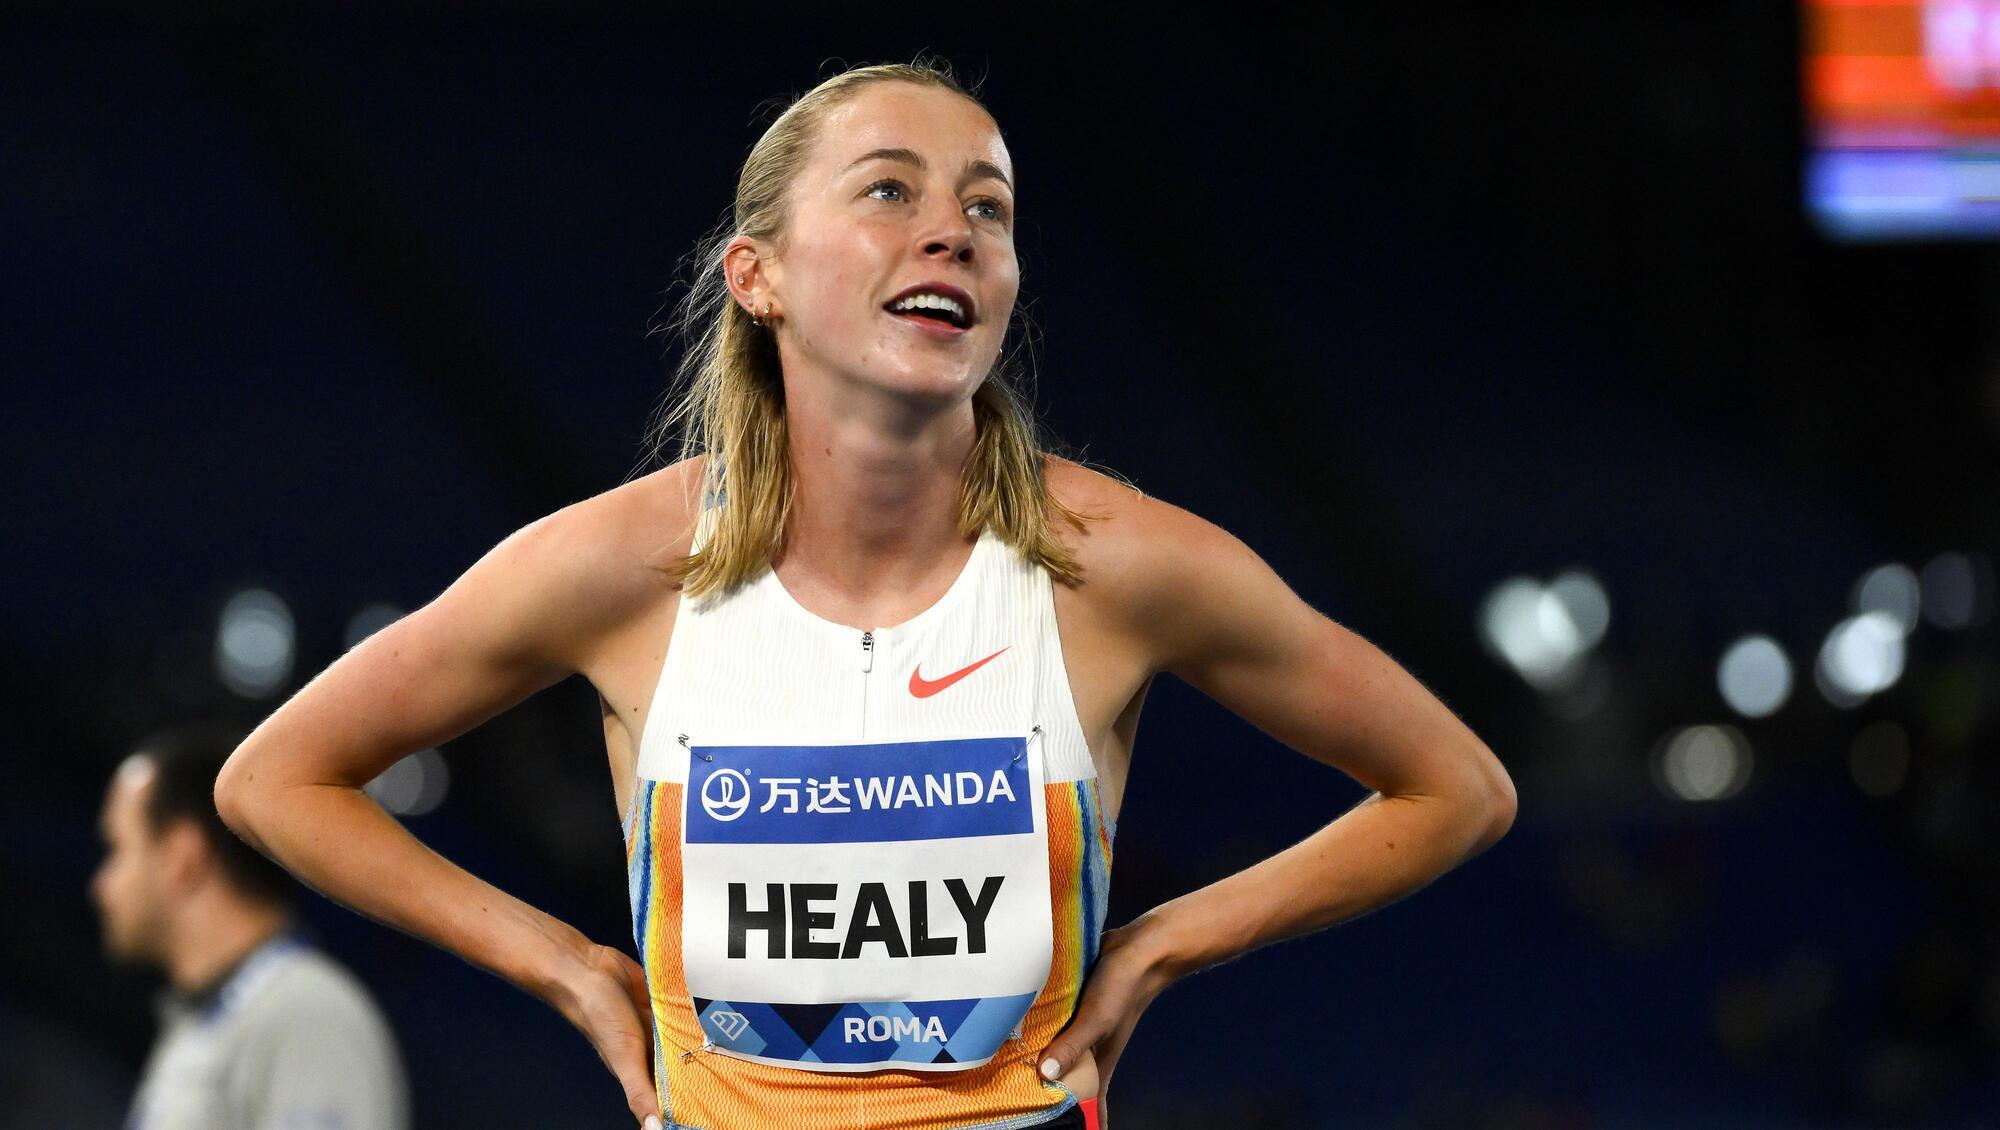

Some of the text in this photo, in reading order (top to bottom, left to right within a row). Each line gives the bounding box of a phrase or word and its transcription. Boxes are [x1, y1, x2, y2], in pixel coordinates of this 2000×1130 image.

[759, 769, 1016, 814] 万达 WANDA
[727, 875, 1006, 960] HEALY
[844, 1015, 948, 1044] ROMA
